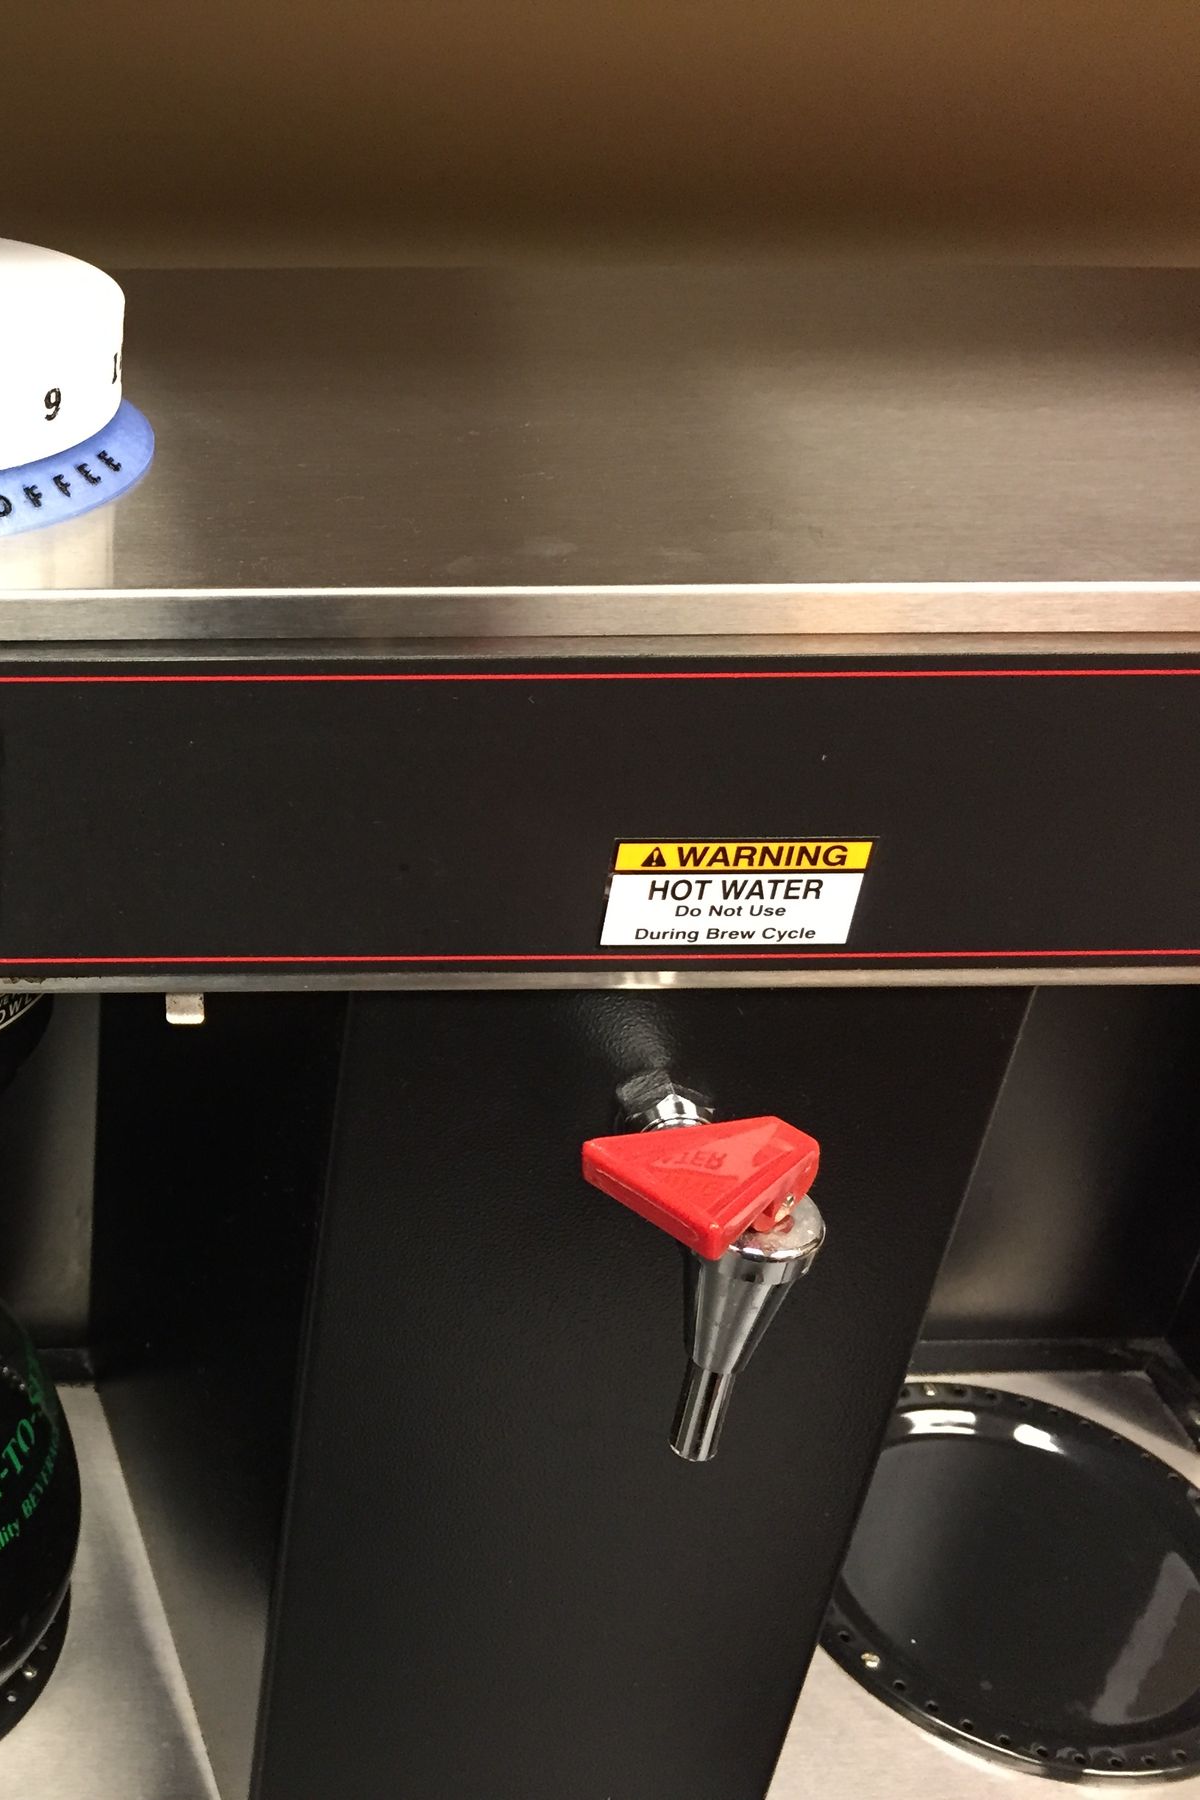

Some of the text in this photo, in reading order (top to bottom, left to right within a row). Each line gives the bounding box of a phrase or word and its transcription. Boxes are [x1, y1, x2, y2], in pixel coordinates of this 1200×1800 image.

[44, 387, 62, 421] 9
[112, 352, 122, 385] 1
[677, 845, 849, 867] WARNING
[648, 879, 824, 901] HOT WATER
[675, 905, 787, 917] Do Not Use
[634, 927, 816, 943] During Brew Cycle
